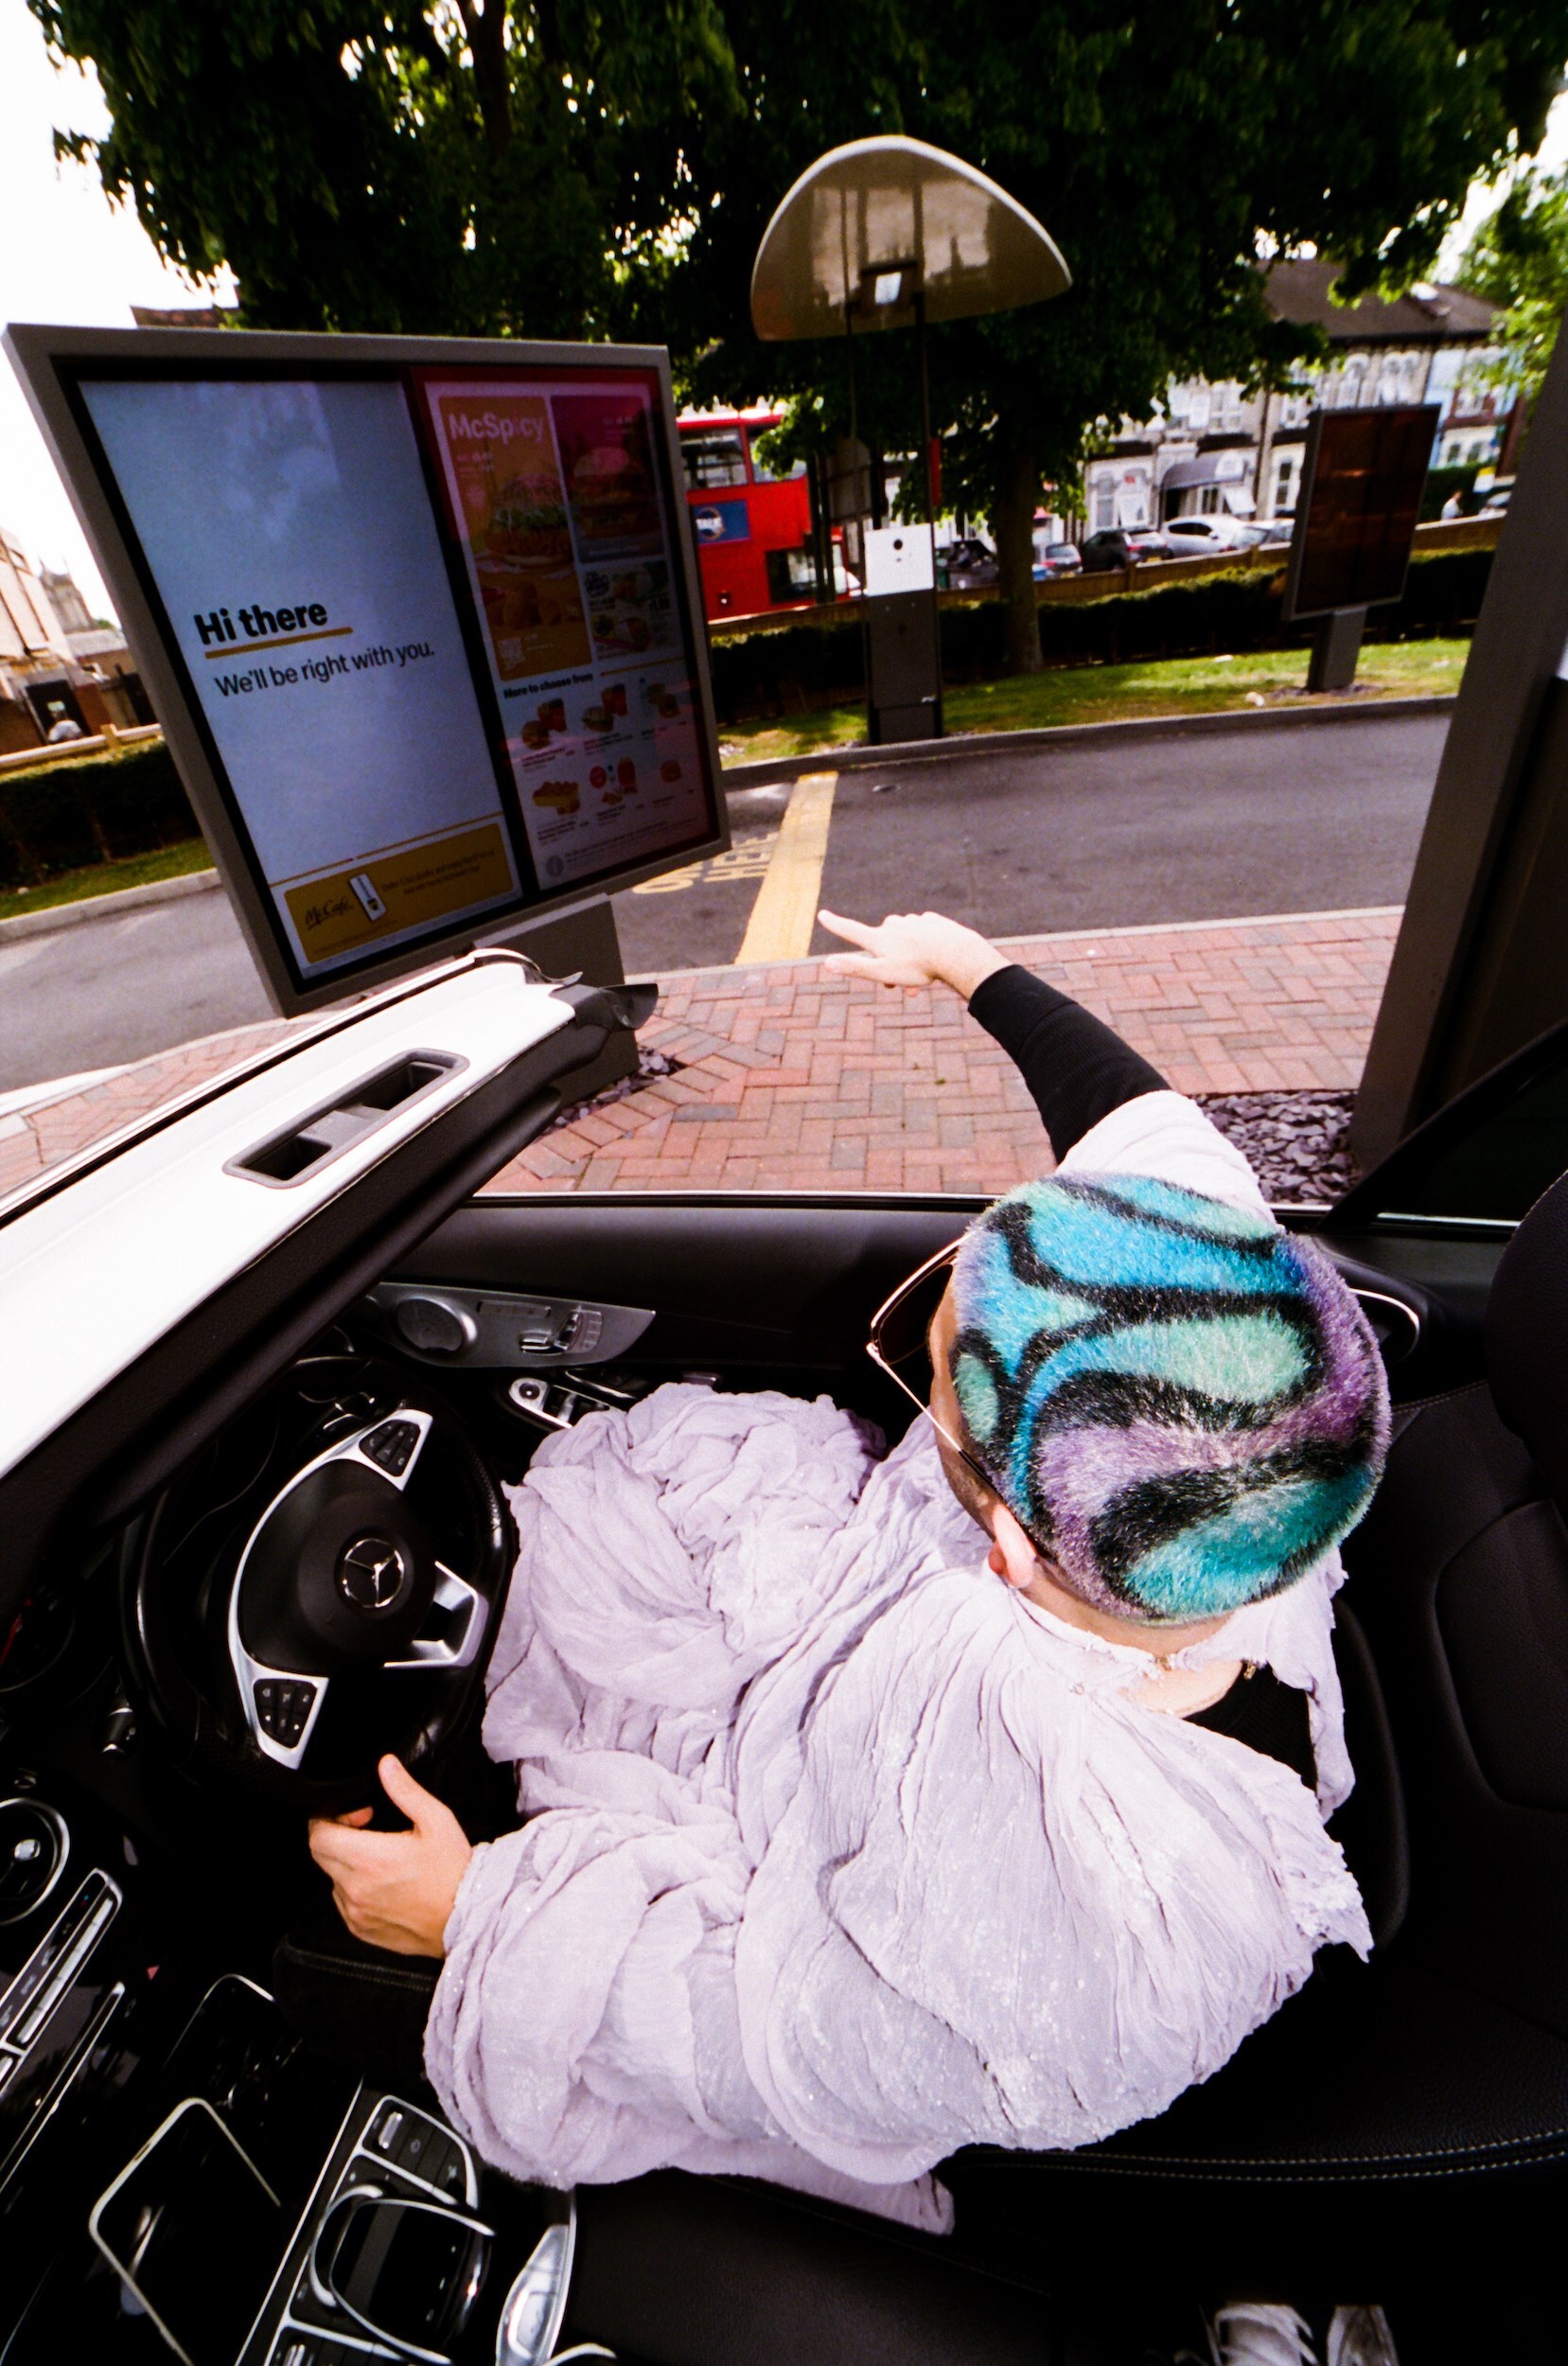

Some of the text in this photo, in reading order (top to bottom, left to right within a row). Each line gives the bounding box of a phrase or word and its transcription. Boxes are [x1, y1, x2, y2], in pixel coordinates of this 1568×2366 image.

[194, 603, 328, 644] Hi there
[214, 642, 435, 697] We'll be right with you.
[503, 673, 593, 698] More to choose from
